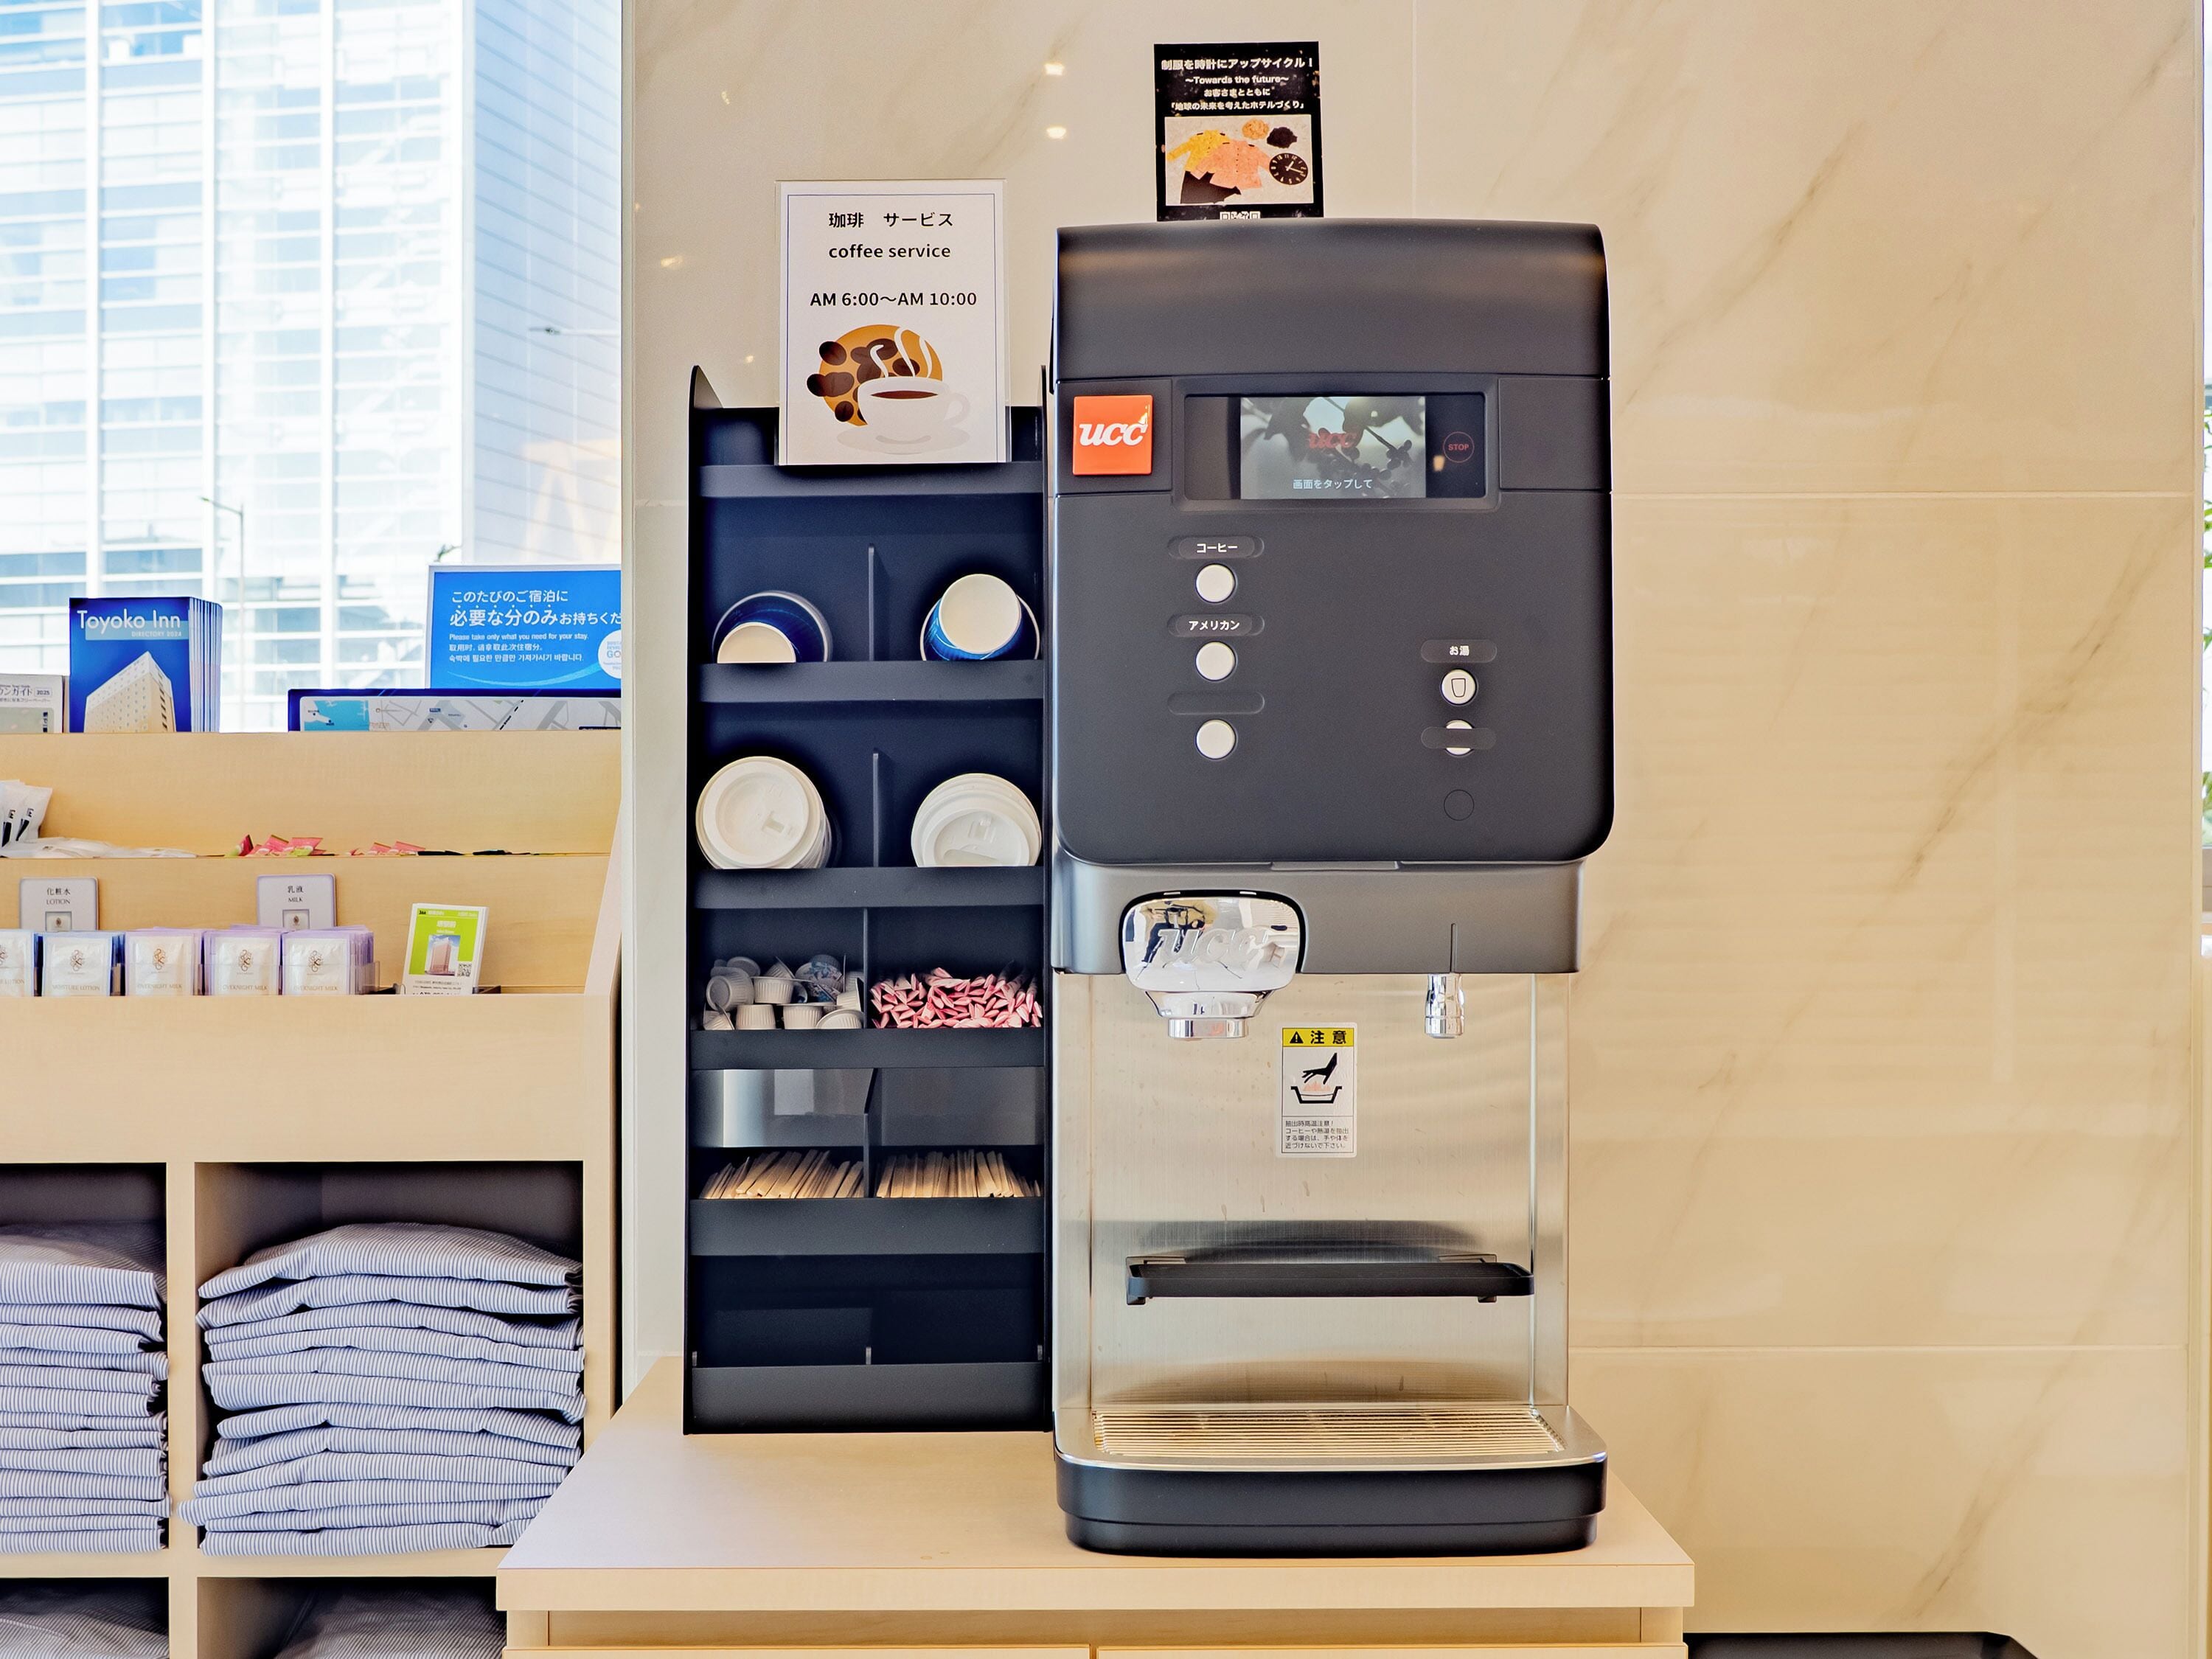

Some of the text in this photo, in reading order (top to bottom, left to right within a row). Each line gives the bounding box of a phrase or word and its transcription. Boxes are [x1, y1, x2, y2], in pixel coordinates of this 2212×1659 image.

[828, 212, 953, 228] 珈琲 サービス
[829, 244, 951, 258] coffee service
[810, 293, 836, 306] AM
[929, 292, 977, 306] 10:00
[1293, 479, 1373, 490] 画面をタップして
[1197, 543, 1238, 553] コーヒー
[451, 590, 568, 603] このたびのご宿泊に
[77, 608, 181, 634] Toyoko Inn
[1189, 620, 1240, 631] アメリカン
[1449, 646, 1470, 656] お湯
[1310, 1030, 1346, 1044] 注意
